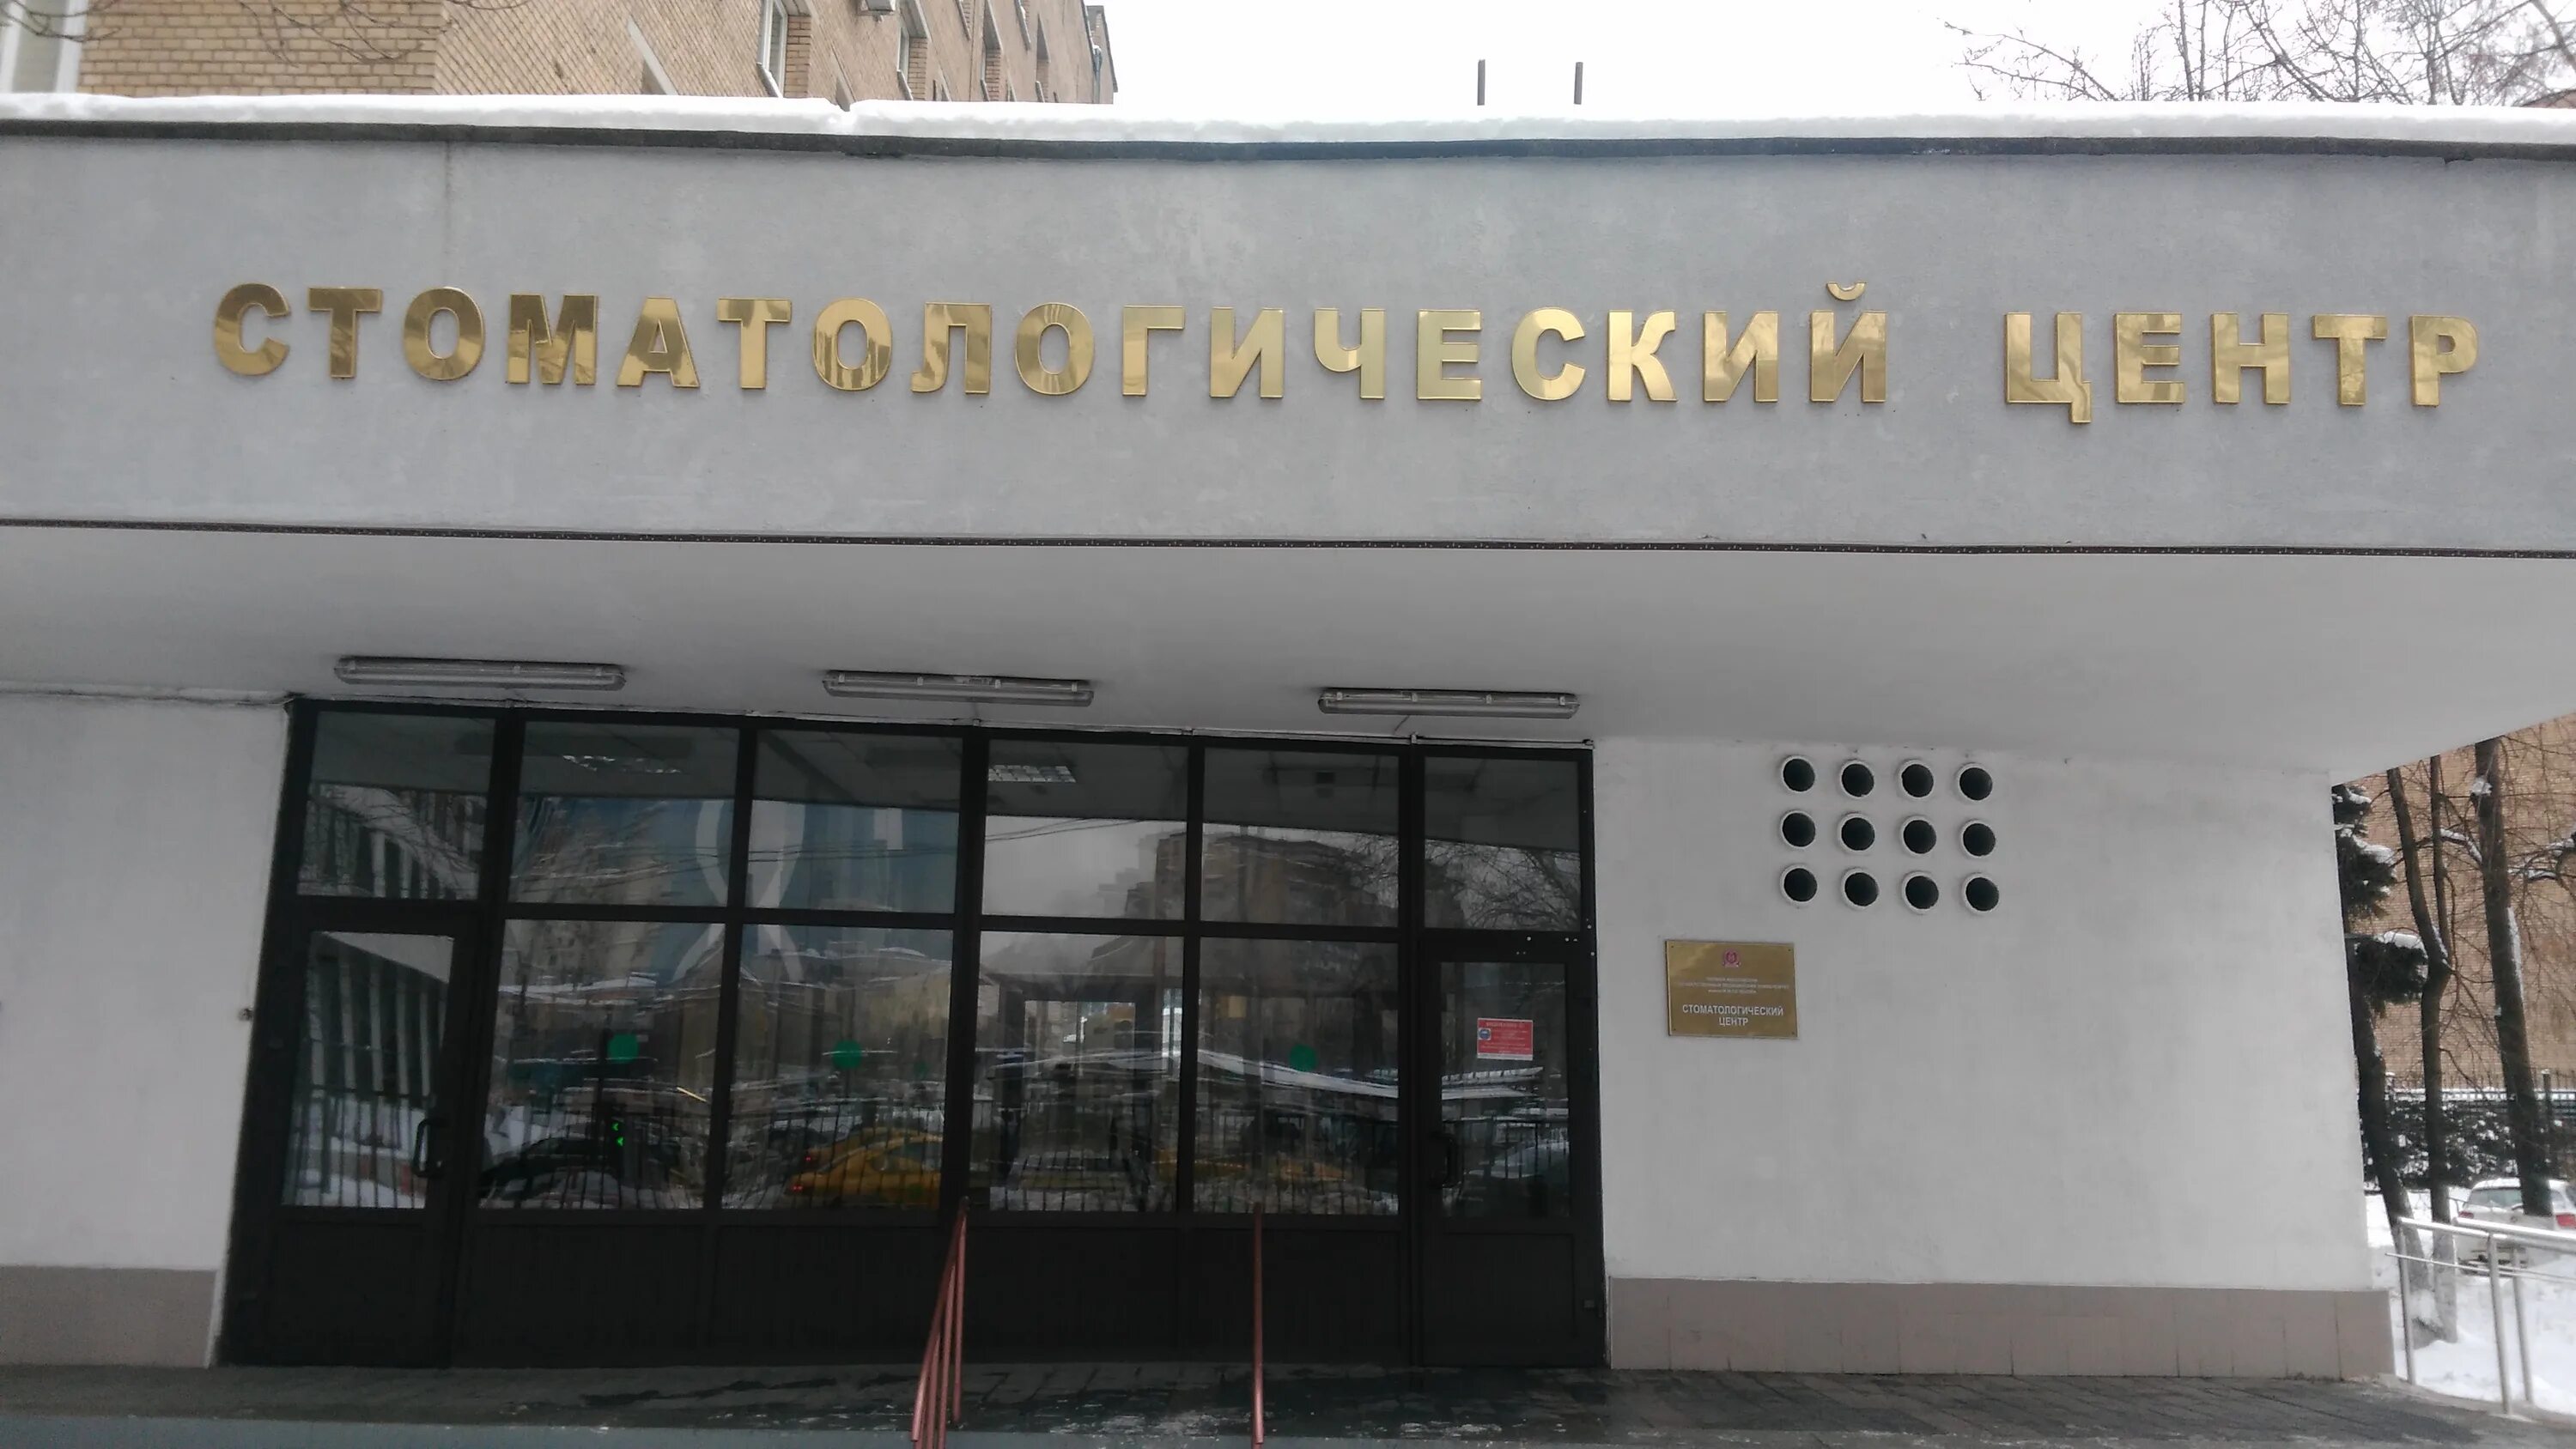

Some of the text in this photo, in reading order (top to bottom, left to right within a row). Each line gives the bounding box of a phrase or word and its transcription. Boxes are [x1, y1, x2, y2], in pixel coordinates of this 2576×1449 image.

[213, 281, 2479, 424] СТОМАТОЛОГИЧЕСКИЙ ЦЕНТР
[1682, 1004, 1783, 1016] СТОМАТОЛОГИЧЕСКИЙ
[1719, 1017, 1748, 1027] ЦЕНТР
